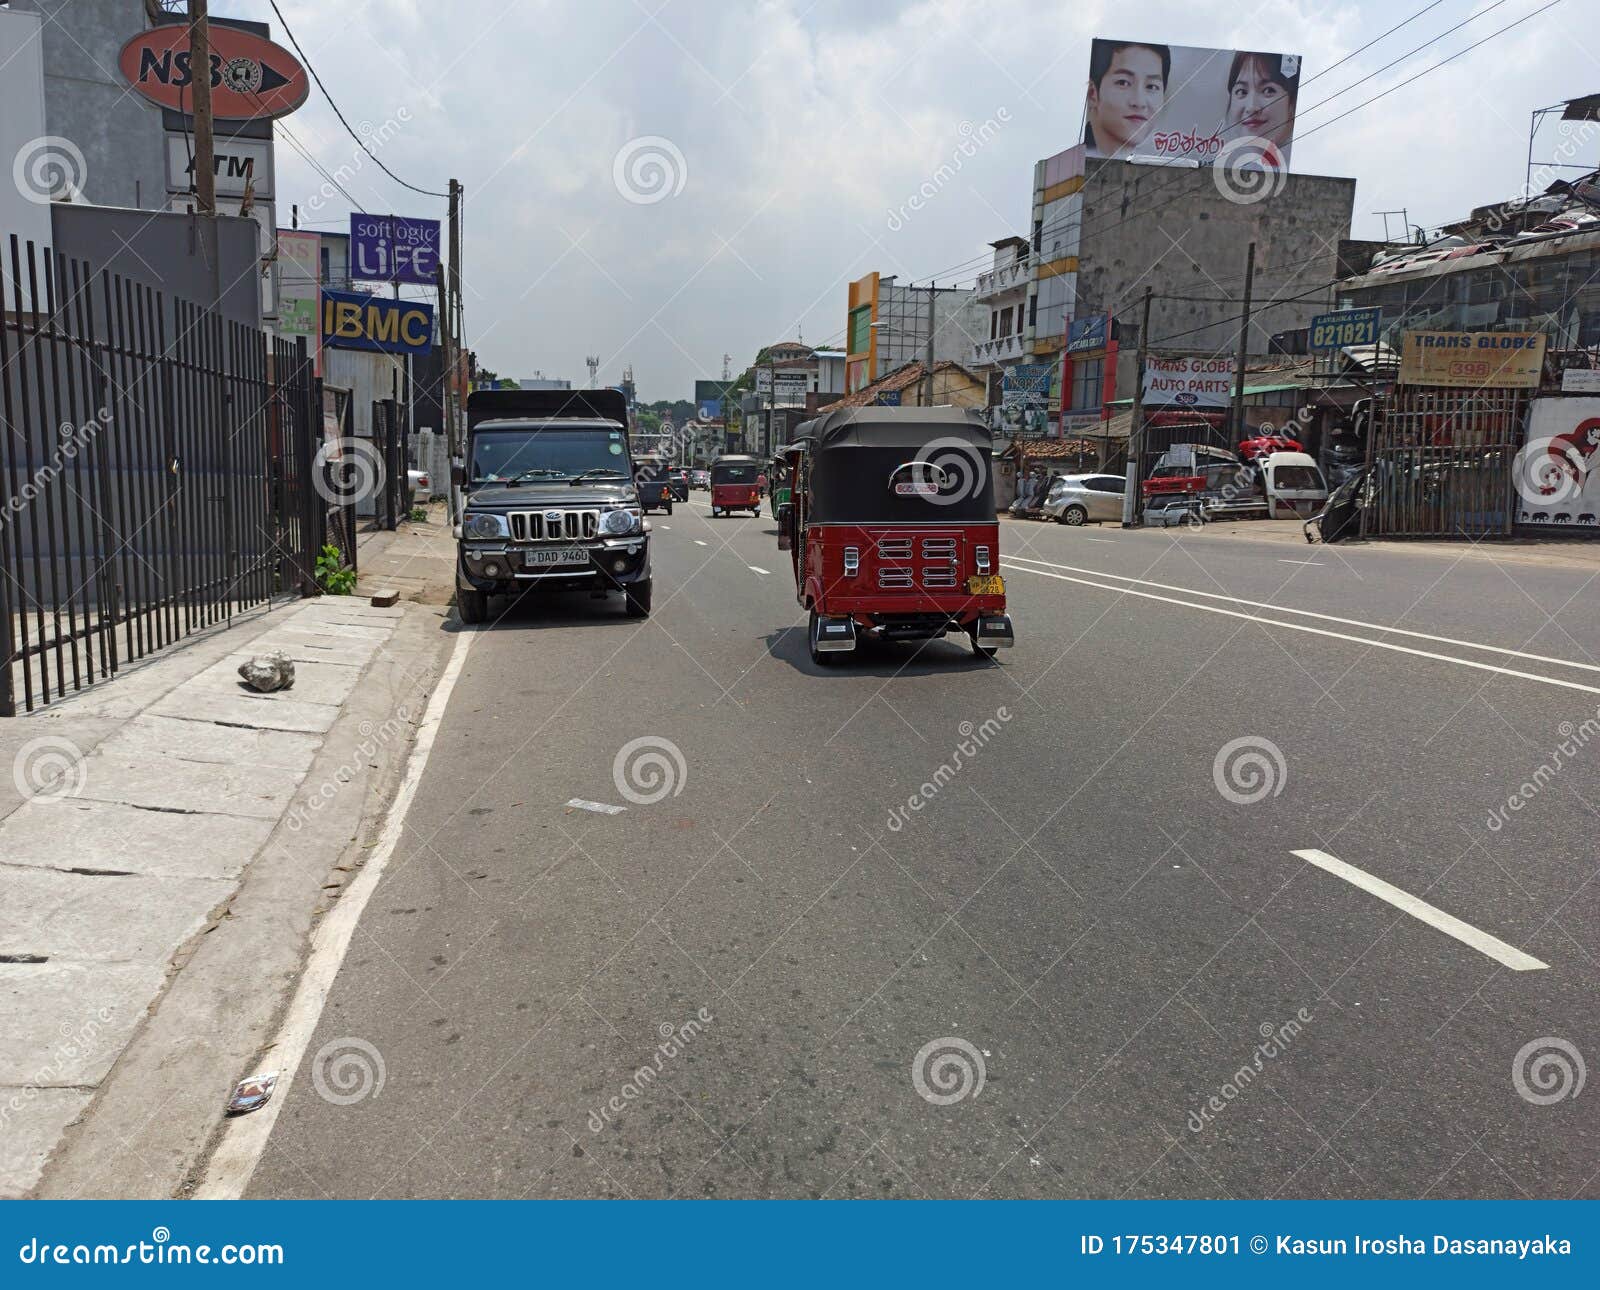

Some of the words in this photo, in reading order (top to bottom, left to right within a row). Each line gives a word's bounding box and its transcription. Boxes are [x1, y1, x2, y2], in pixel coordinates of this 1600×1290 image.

[324, 299, 429, 346] IBMC
[1313, 321, 1374, 346] 821821
[1415, 335, 1472, 348] TRANS
[1477, 336, 1537, 349] GLOBE
[1147, 358, 1188, 373] TRANS
[1191, 360, 1233, 373] GLOBE
[1452, 363, 1488, 376] 398
[1008, 376, 1045, 392] WORKS
[1151, 378, 1185, 392] AUTO
[1188, 380, 1230, 393] PARTS
[537, 552, 558, 562] DAD
[562, 551, 588, 561] 9460
